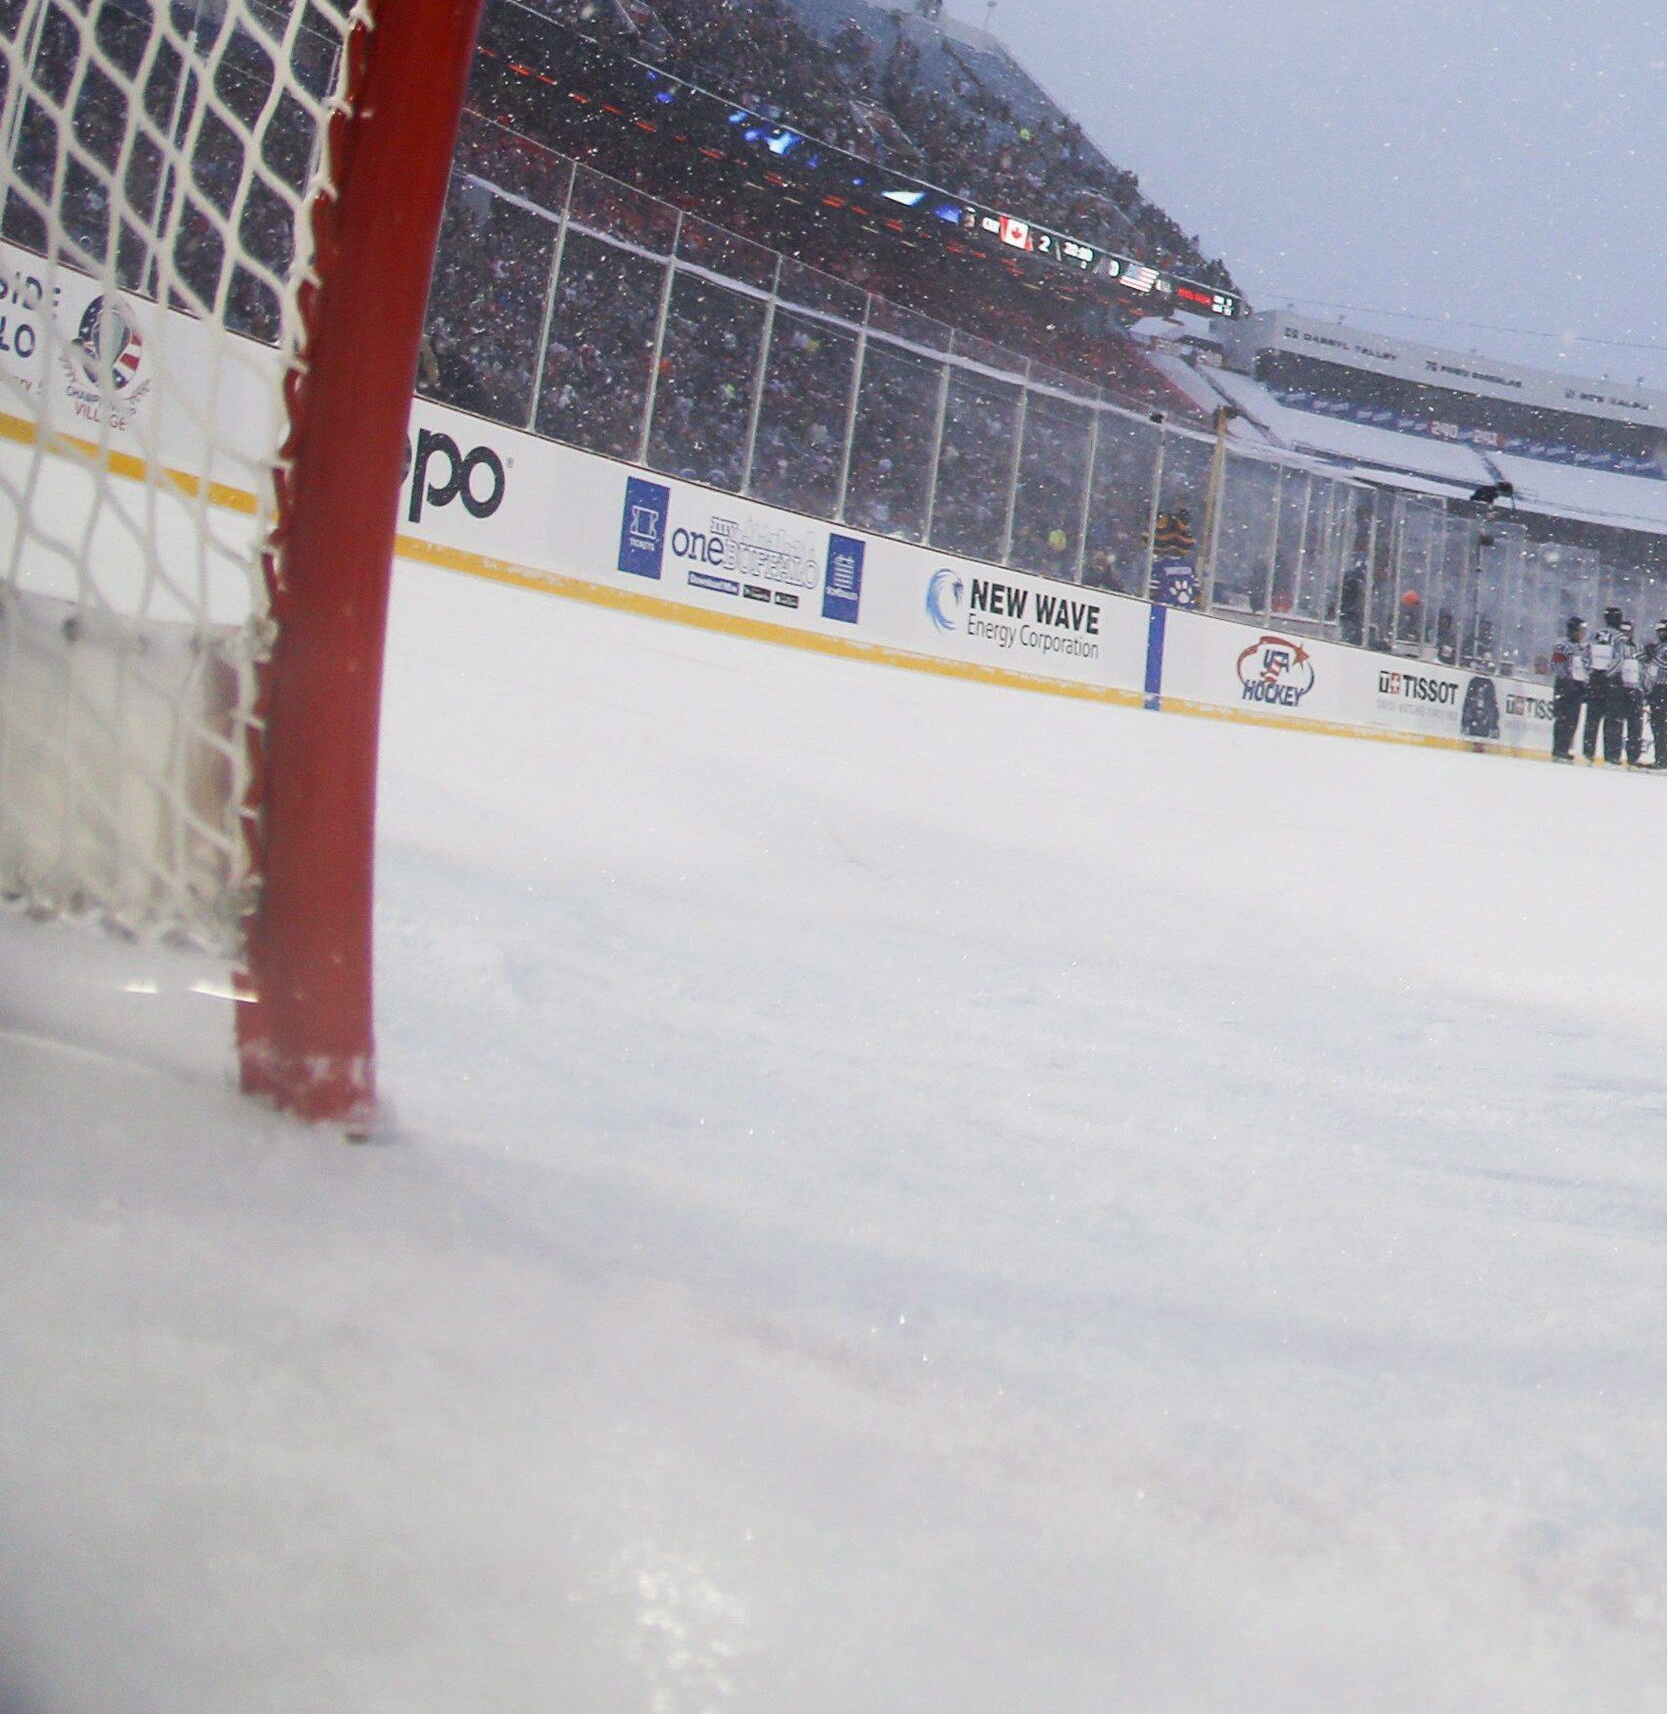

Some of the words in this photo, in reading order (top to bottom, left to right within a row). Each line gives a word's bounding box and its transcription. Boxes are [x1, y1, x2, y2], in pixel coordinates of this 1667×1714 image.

[75, 401, 127, 432] VILLGE
[402, 427, 505, 524] po
[970, 578, 1028, 620] NEW
[1035, 592, 1101, 635] WAVE
[967, 612, 1018, 649] Energy
[1020, 623, 1099, 660] Corporation
[1241, 678, 1304, 708] HOCKEY
[1402, 673, 1459, 706] TISSOT
